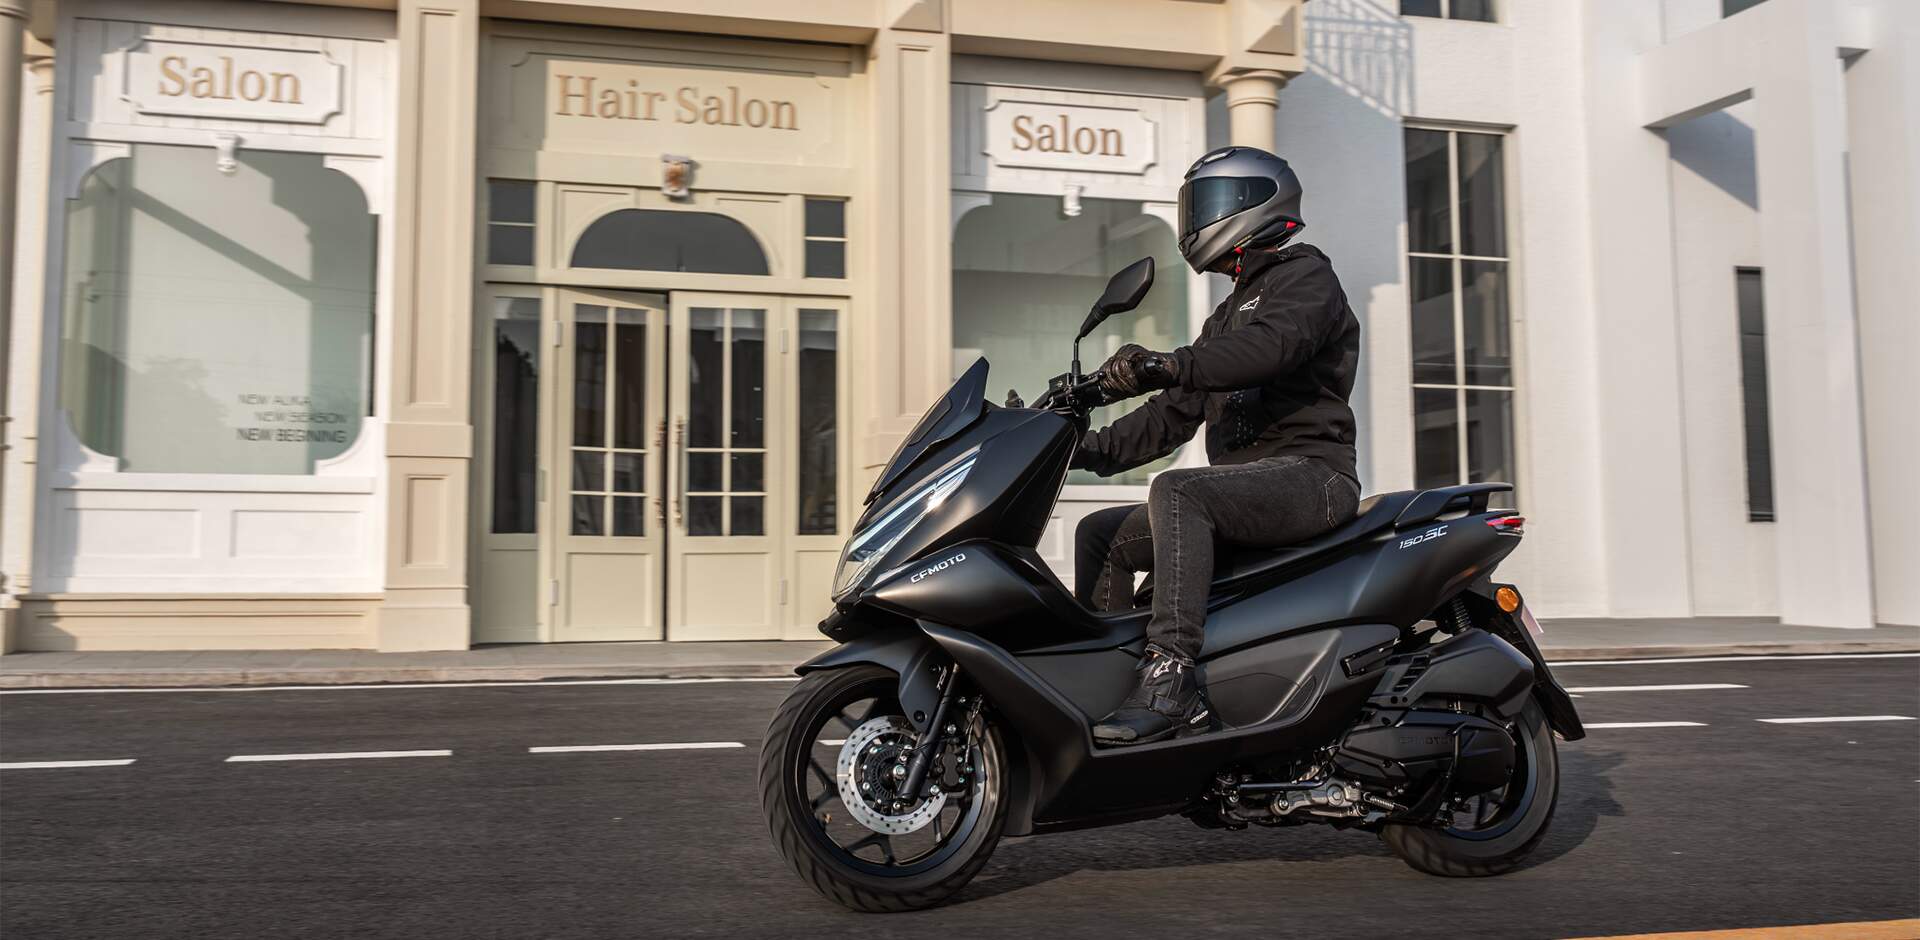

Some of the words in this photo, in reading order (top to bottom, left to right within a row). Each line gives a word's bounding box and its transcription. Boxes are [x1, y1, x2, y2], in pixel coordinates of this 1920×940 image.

[158, 55, 304, 104] Salon
[554, 74, 667, 121] Hair
[673, 86, 800, 131] Salon
[1011, 114, 1126, 157] Salon
[238, 393, 268, 405] NEW
[254, 411, 286, 422] NEW
[288, 412, 347, 424] SEASON
[236, 428, 272, 441] NEW
[910, 553, 966, 583] CFMOTO
